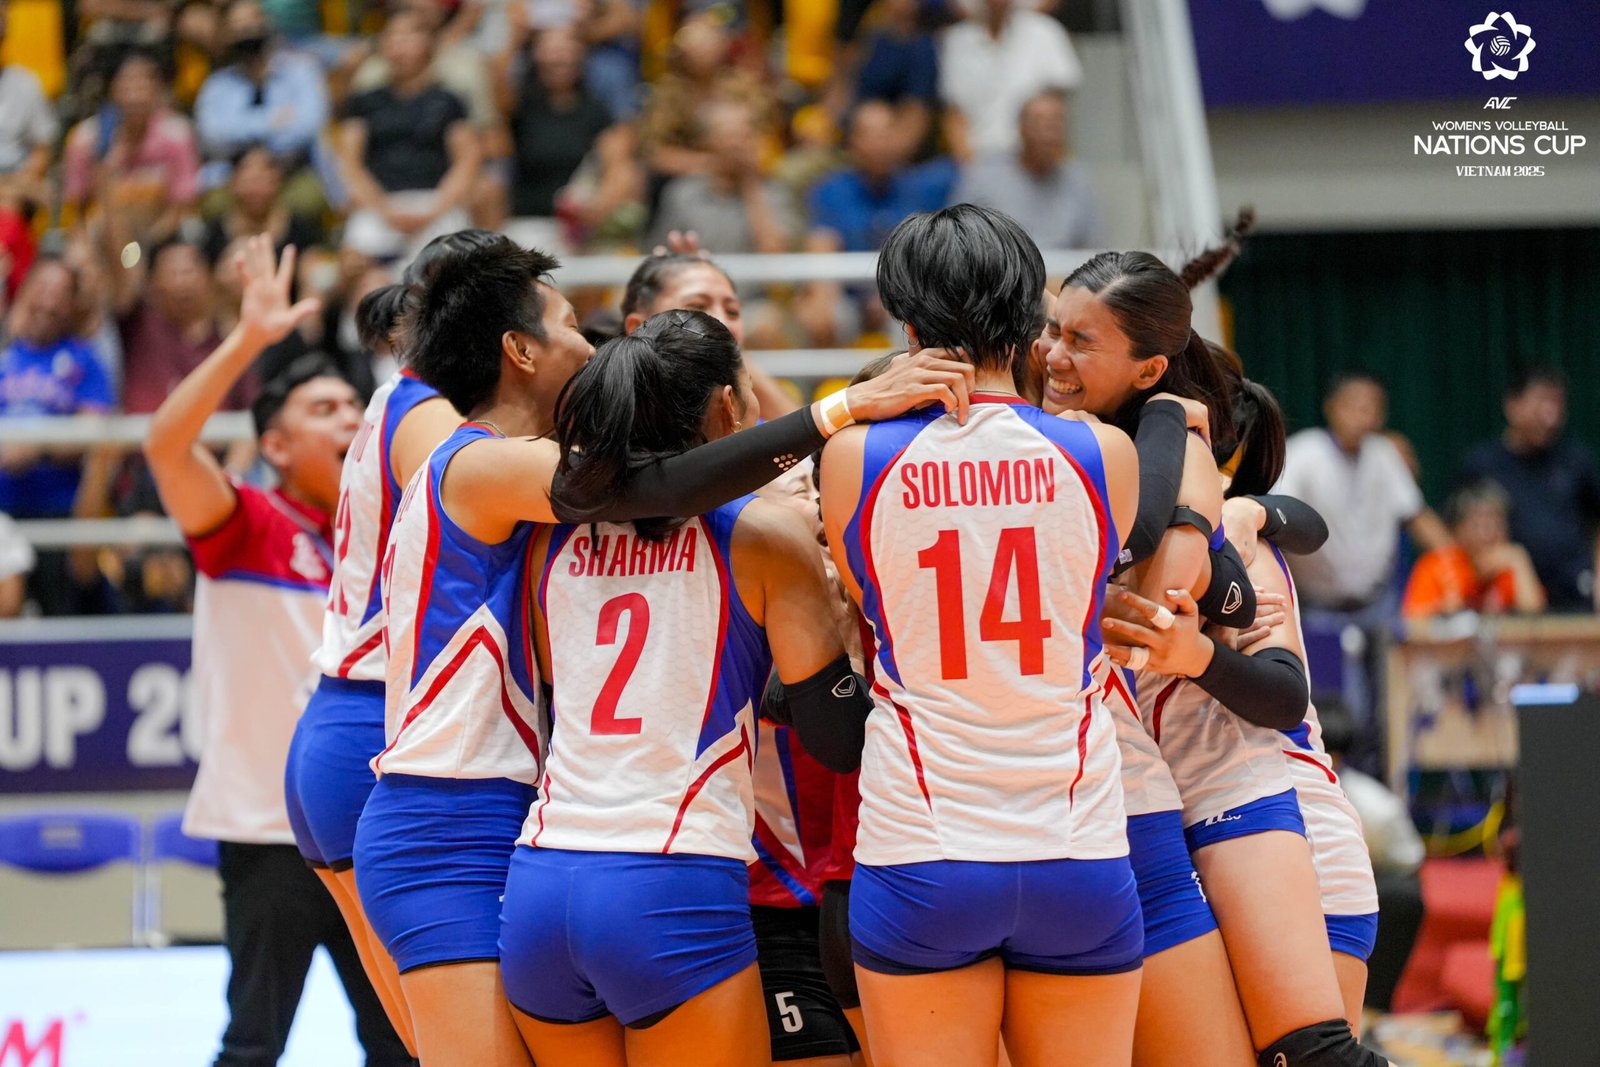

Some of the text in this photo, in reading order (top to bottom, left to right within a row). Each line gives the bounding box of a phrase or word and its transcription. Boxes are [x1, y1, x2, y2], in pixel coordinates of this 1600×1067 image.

[900, 457, 1056, 510] SOLOMON
[567, 526, 698, 578] SHARMA
[917, 526, 1052, 681] 14
[589, 591, 651, 736] 2
[774, 990, 804, 1033] 5
